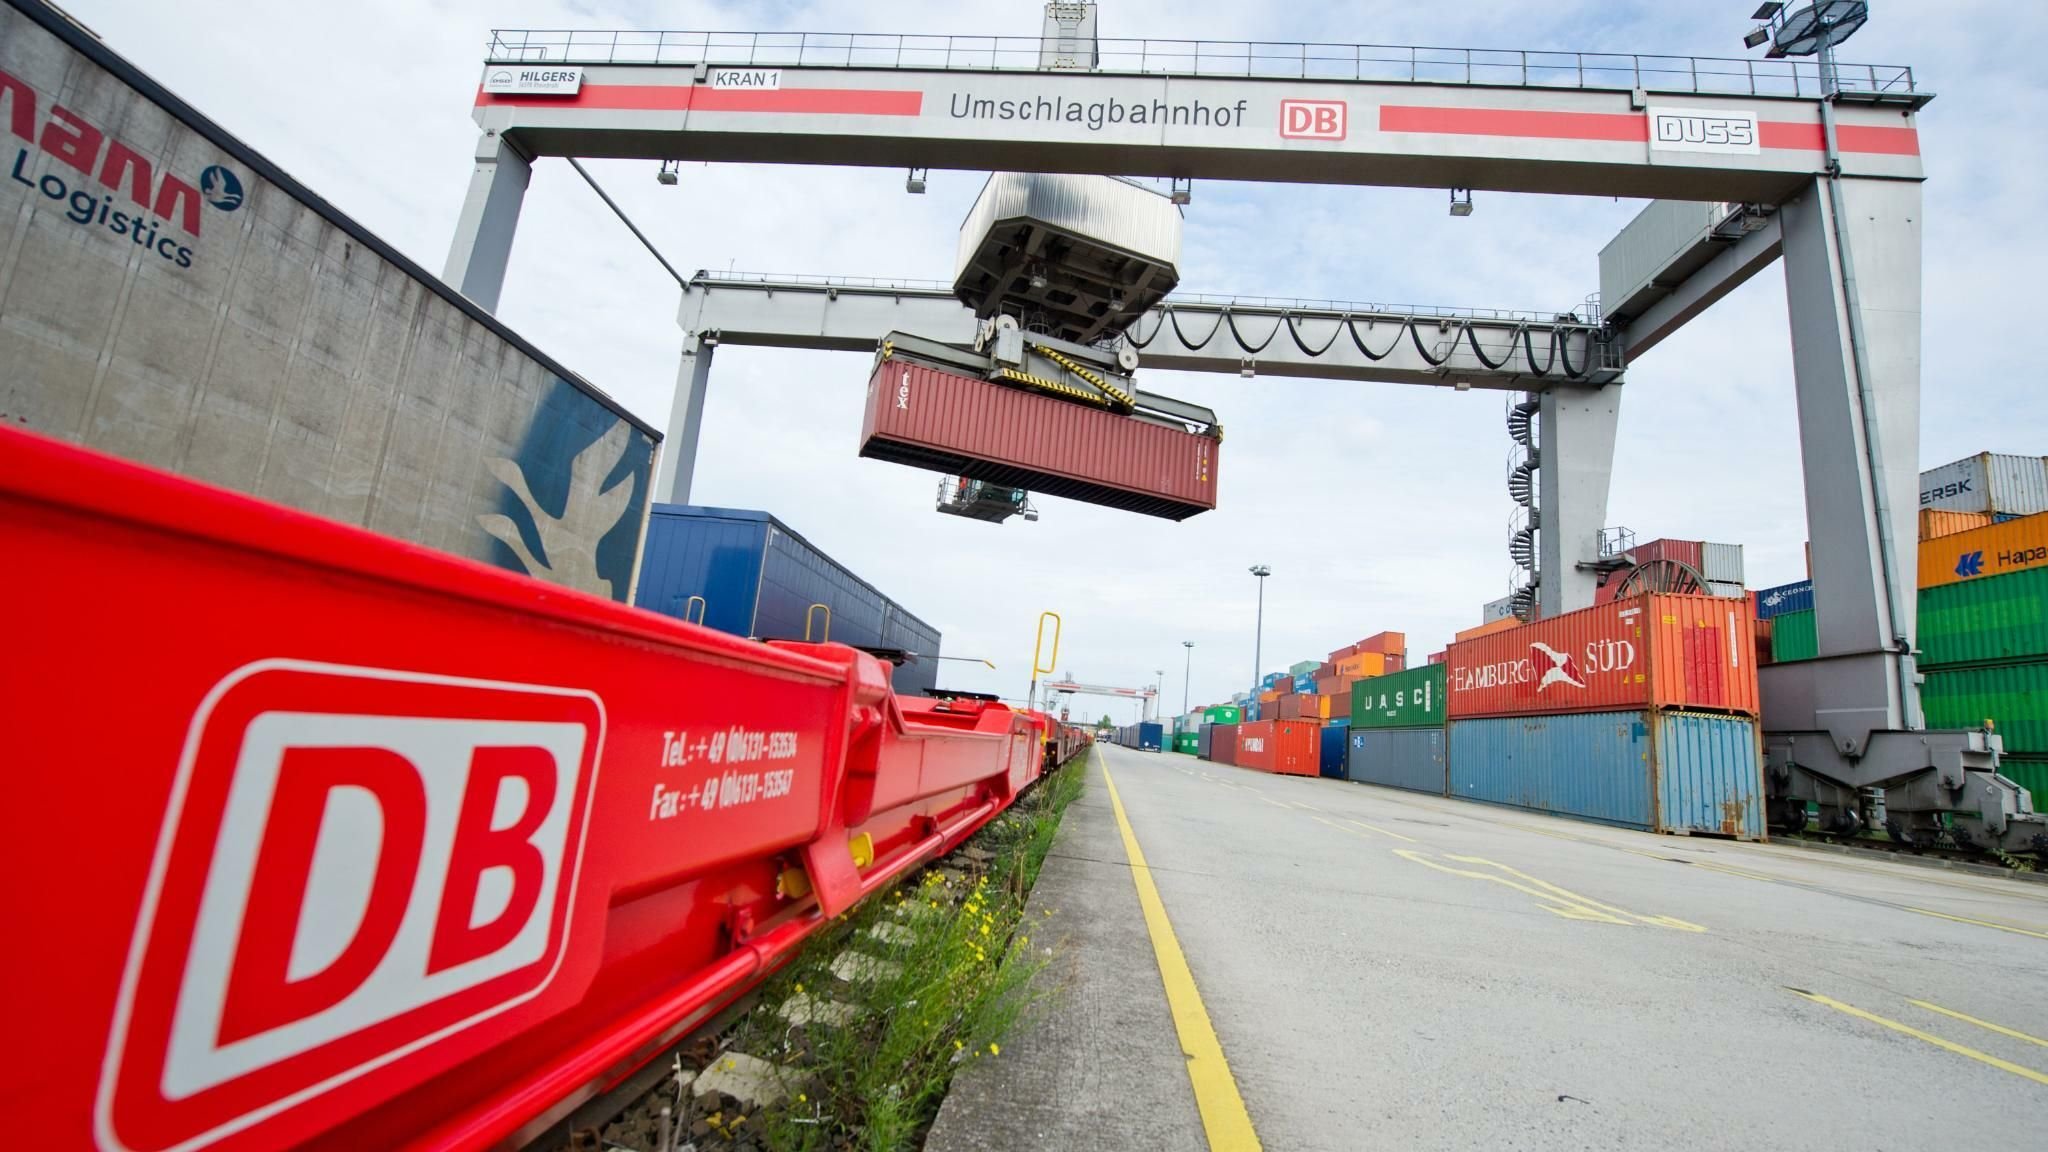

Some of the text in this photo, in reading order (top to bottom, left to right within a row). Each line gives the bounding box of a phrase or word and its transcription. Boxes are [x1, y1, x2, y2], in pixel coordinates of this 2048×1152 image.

[520, 71, 576, 82] HILGERS
[716, 72, 777, 86] KRAN 1
[950, 93, 1247, 130] Umschlagbahnhof
[1287, 106, 1339, 134] DB
[1657, 115, 1752, 145] DUSS
[11, 148, 193, 268] Logistics
[897, 371, 910, 409] tex
[1997, 546, 2048, 566] Hapa
[1455, 638, 1635, 691] HAMBURG SÜD
[213, 744, 559, 1050] DB
